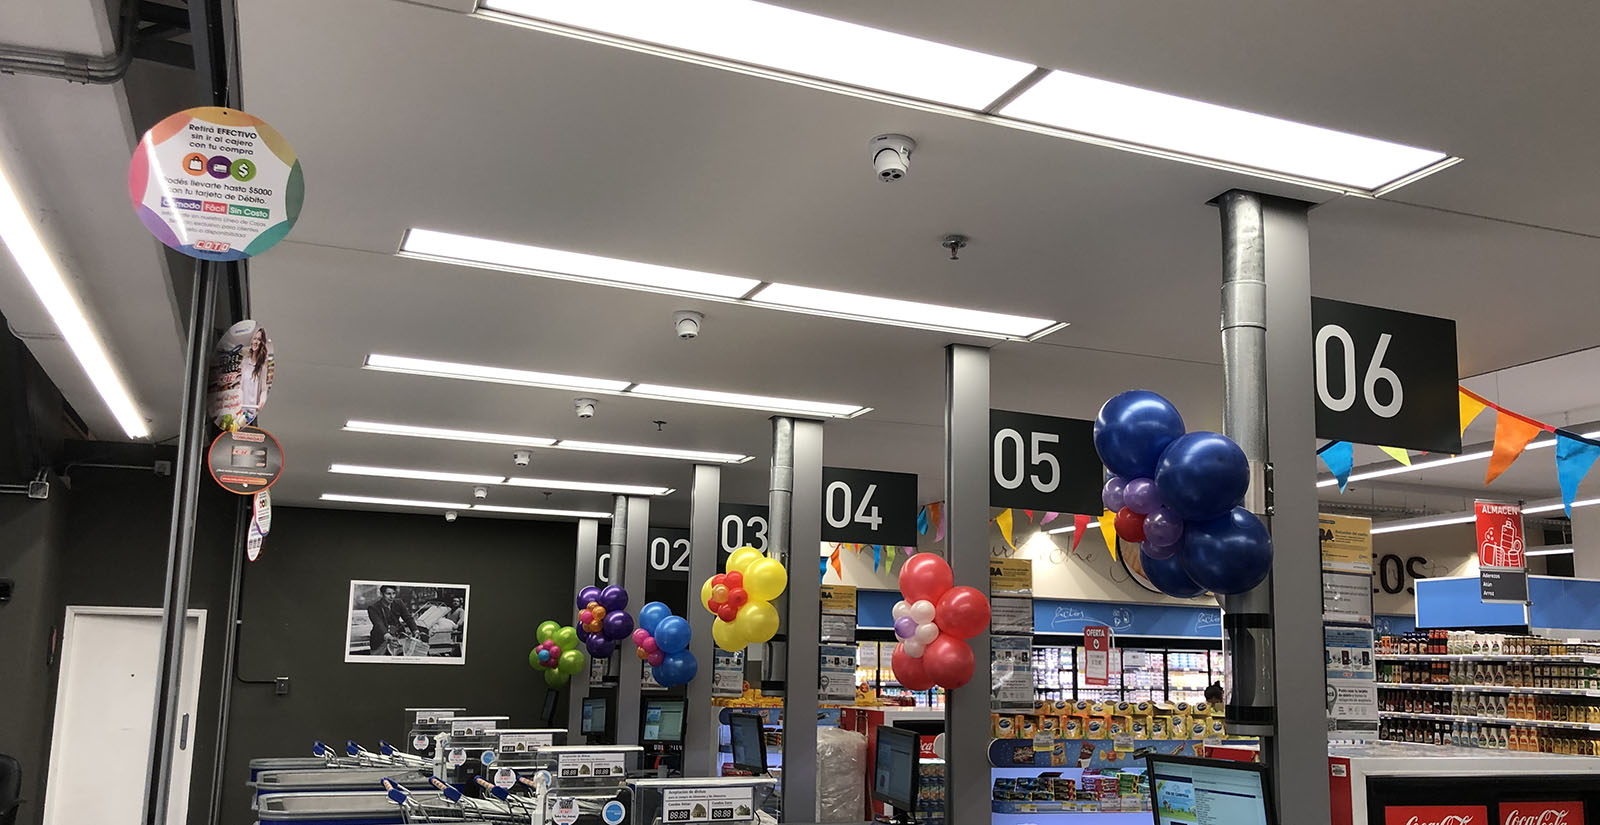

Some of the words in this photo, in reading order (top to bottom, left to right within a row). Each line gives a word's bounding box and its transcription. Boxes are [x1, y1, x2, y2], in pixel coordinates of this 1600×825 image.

[189, 124, 214, 134] Retirá
[217, 128, 257, 139] EFECTIVO
[219, 146, 254, 155] compra
[225, 138, 253, 147] cajero
[191, 179, 222, 190] llevarte
[224, 184, 246, 193] hasta
[249, 186, 272, 197] $5000
[195, 190, 224, 200] tarjeta
[238, 194, 267, 204] Débito.
[163, 198, 200, 210] Cmodo
[205, 203, 225, 212] Fácil
[230, 206, 242, 215] Sin
[244, 208, 268, 218] Costo
[196, 241, 230, 251] COTO
[1315, 324, 1404, 418] 06
[993, 426, 1061, 494] 05
[826, 479, 883, 531] 04
[1482, 505, 1519, 515] ALMACEN
[722, 514, 768, 554] 03
[650, 537, 690, 571] 02
[598, 554, 611, 582] 0
[1372, 554, 1427, 597] OS
[1086, 629, 1105, 637] OFERTA
